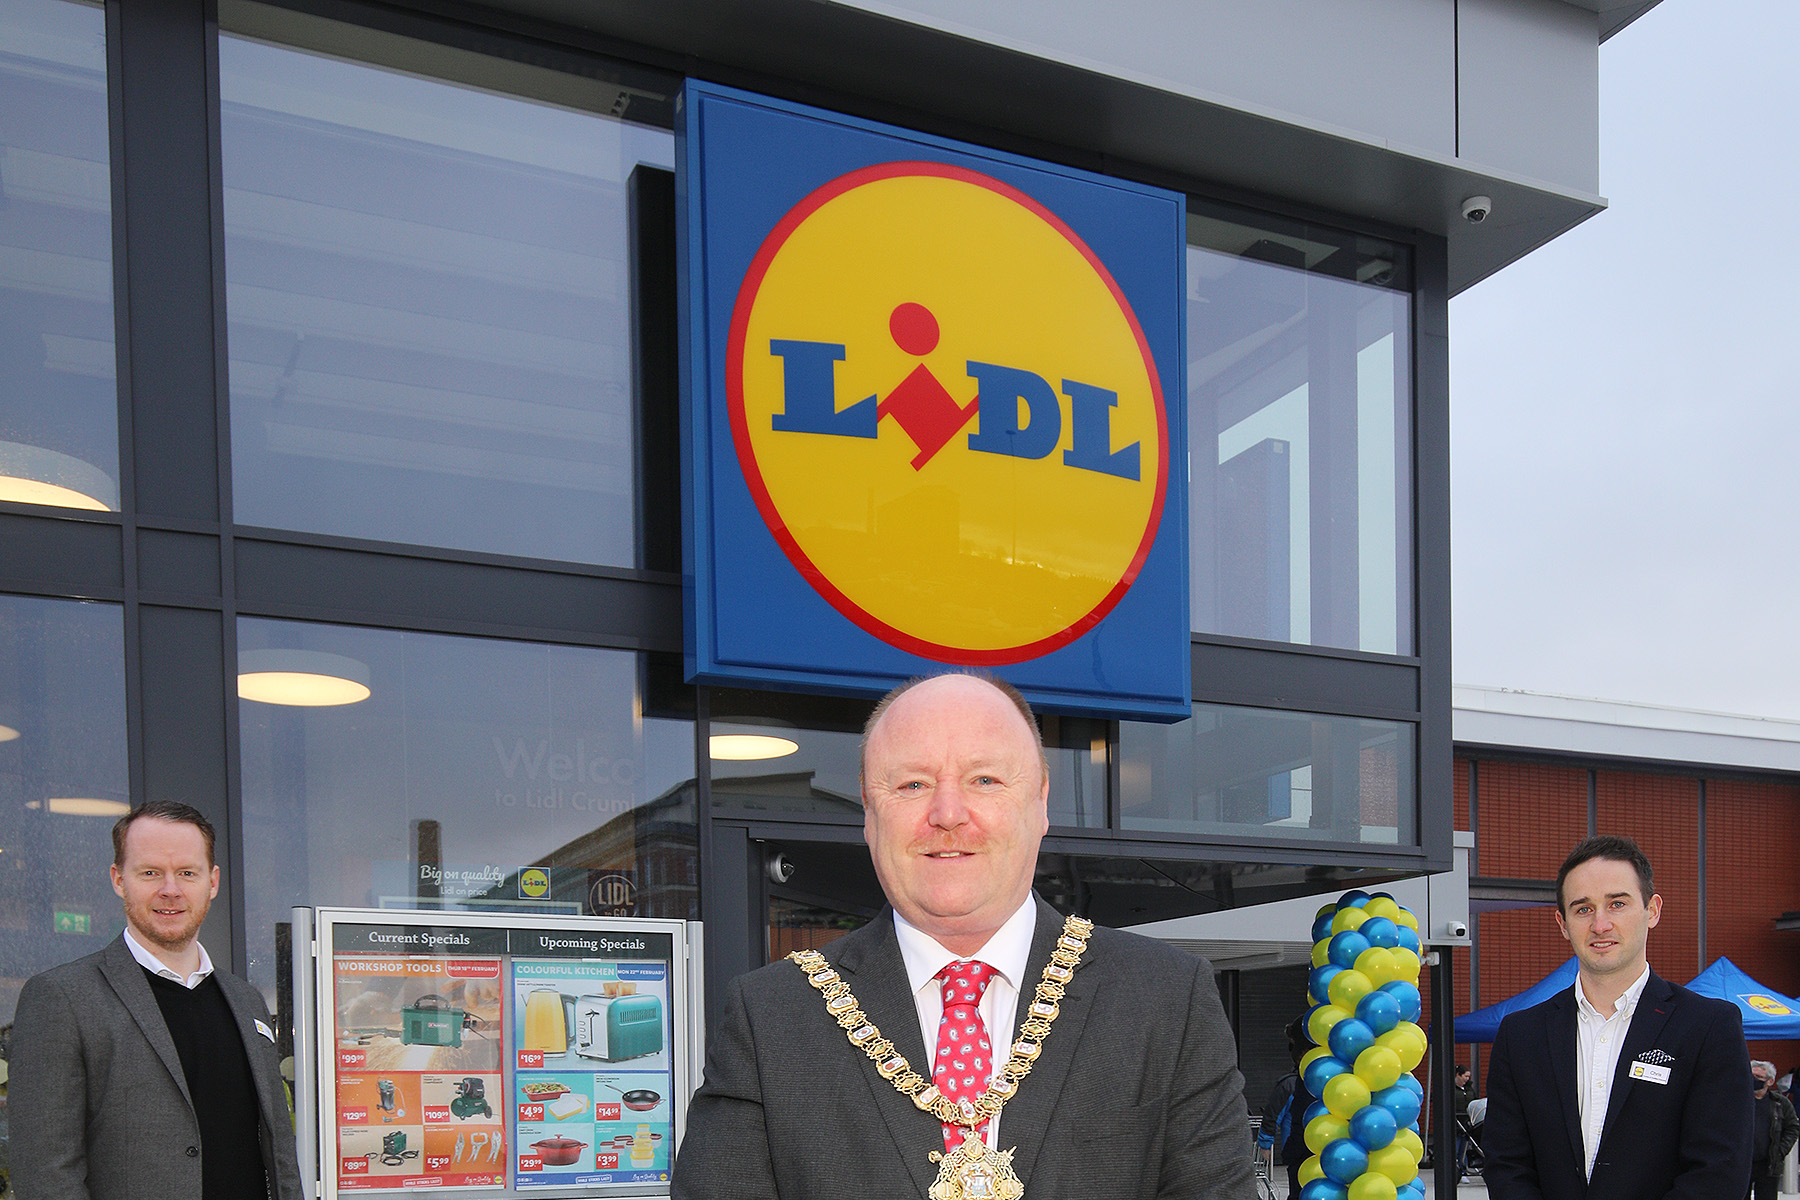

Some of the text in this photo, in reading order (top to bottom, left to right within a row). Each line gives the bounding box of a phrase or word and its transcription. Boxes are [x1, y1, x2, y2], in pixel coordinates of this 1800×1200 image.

[495, 790, 517, 807] to
[526, 788, 562, 809] Lidl
[420, 864, 505, 888] Big on quality
[440, 886, 488, 897] Lidl on price
[598, 882, 634, 906] LIDL
[368, 931, 471, 947] Current Specials
[540, 936, 645, 951] Upcoming Specials
[338, 962, 442, 973] WORKSHOP TOOLS
[517, 966, 615, 976] COLOURFUL KITCHEN
[520, 1106, 543, 1118] £4.99
[427, 1157, 449, 1168] £5.99
[597, 1156, 617, 1166] £3.99
